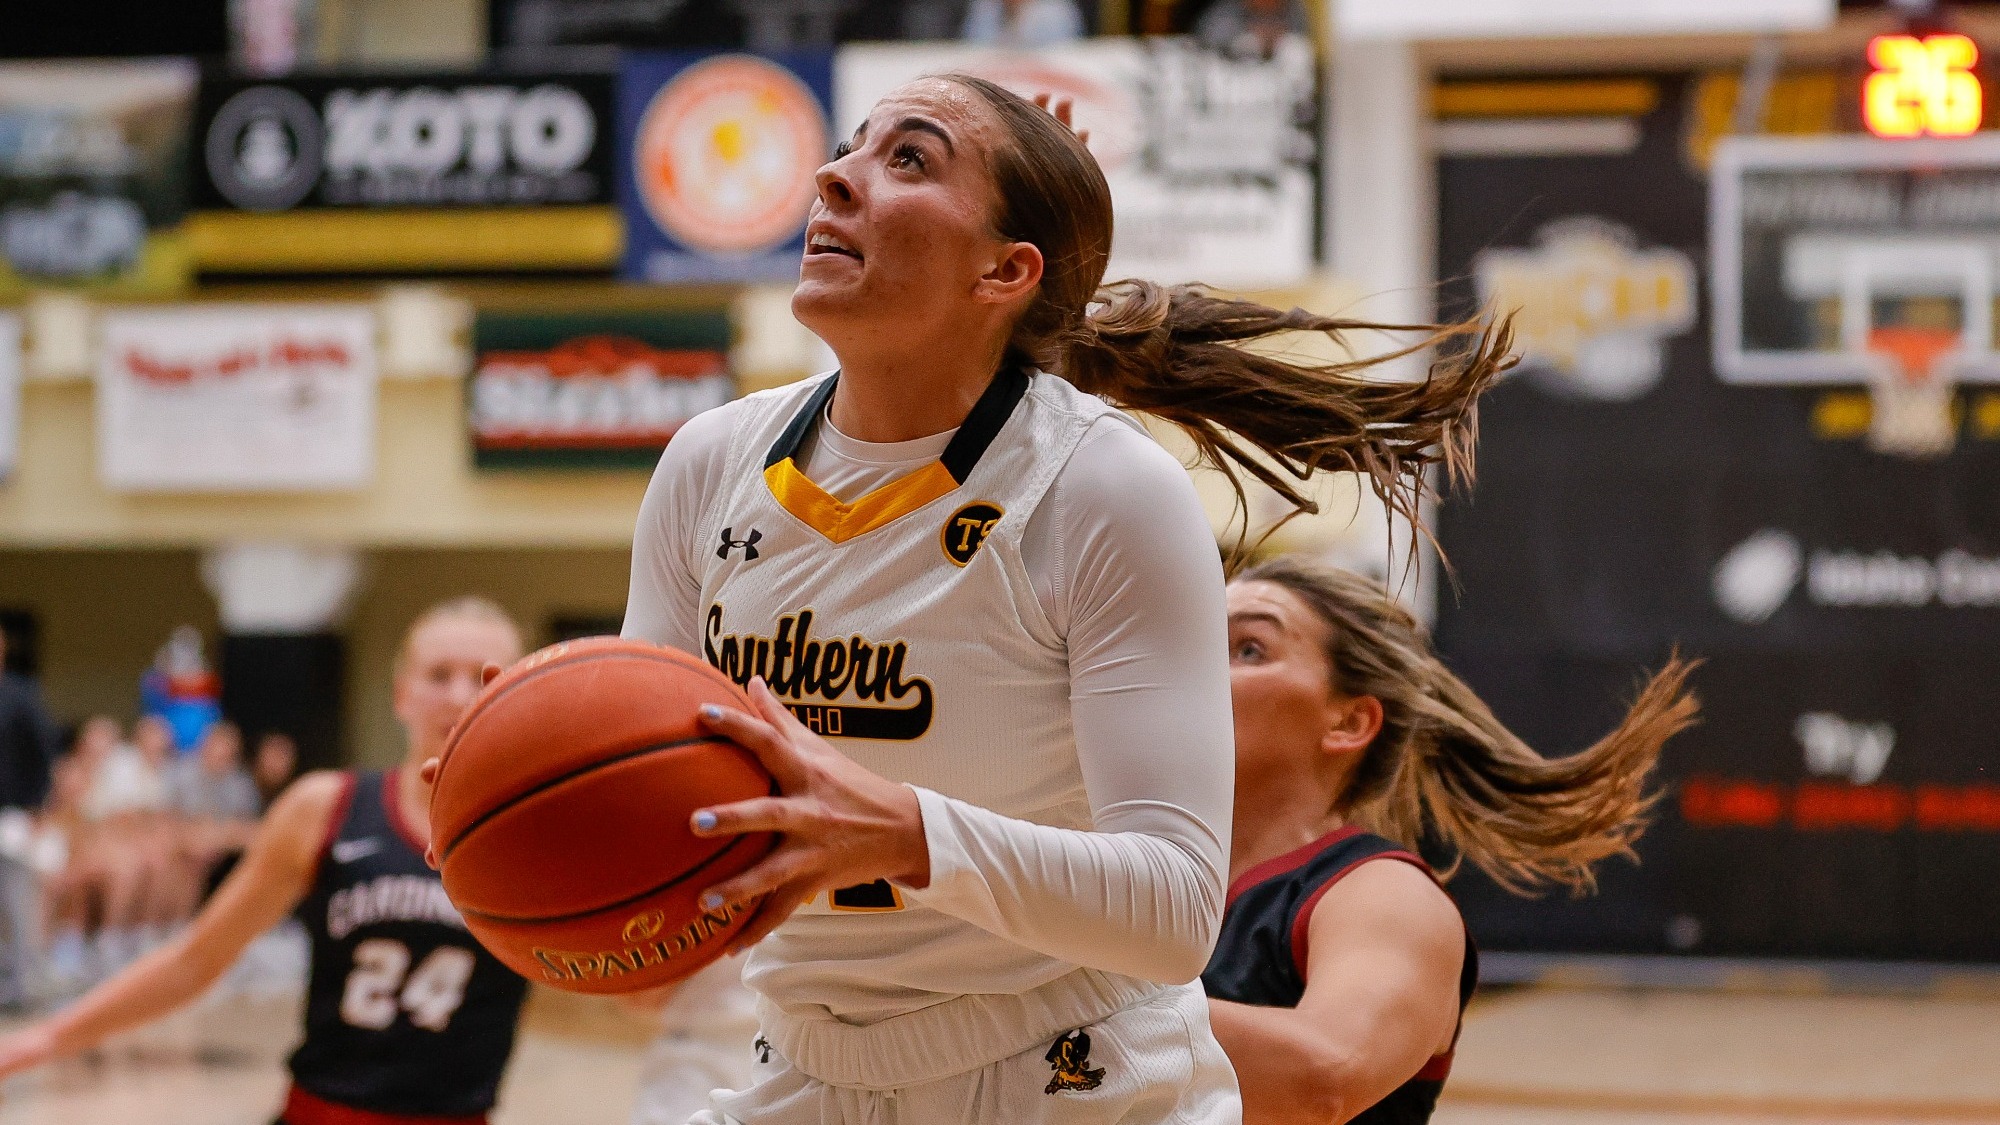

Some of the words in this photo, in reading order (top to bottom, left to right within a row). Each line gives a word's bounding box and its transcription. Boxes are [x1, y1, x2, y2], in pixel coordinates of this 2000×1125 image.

[322, 87, 597, 174] KOTO
[1864, 36, 1981, 138] 26
[704, 603, 932, 702] Southern
[339, 937, 476, 1032] 24
